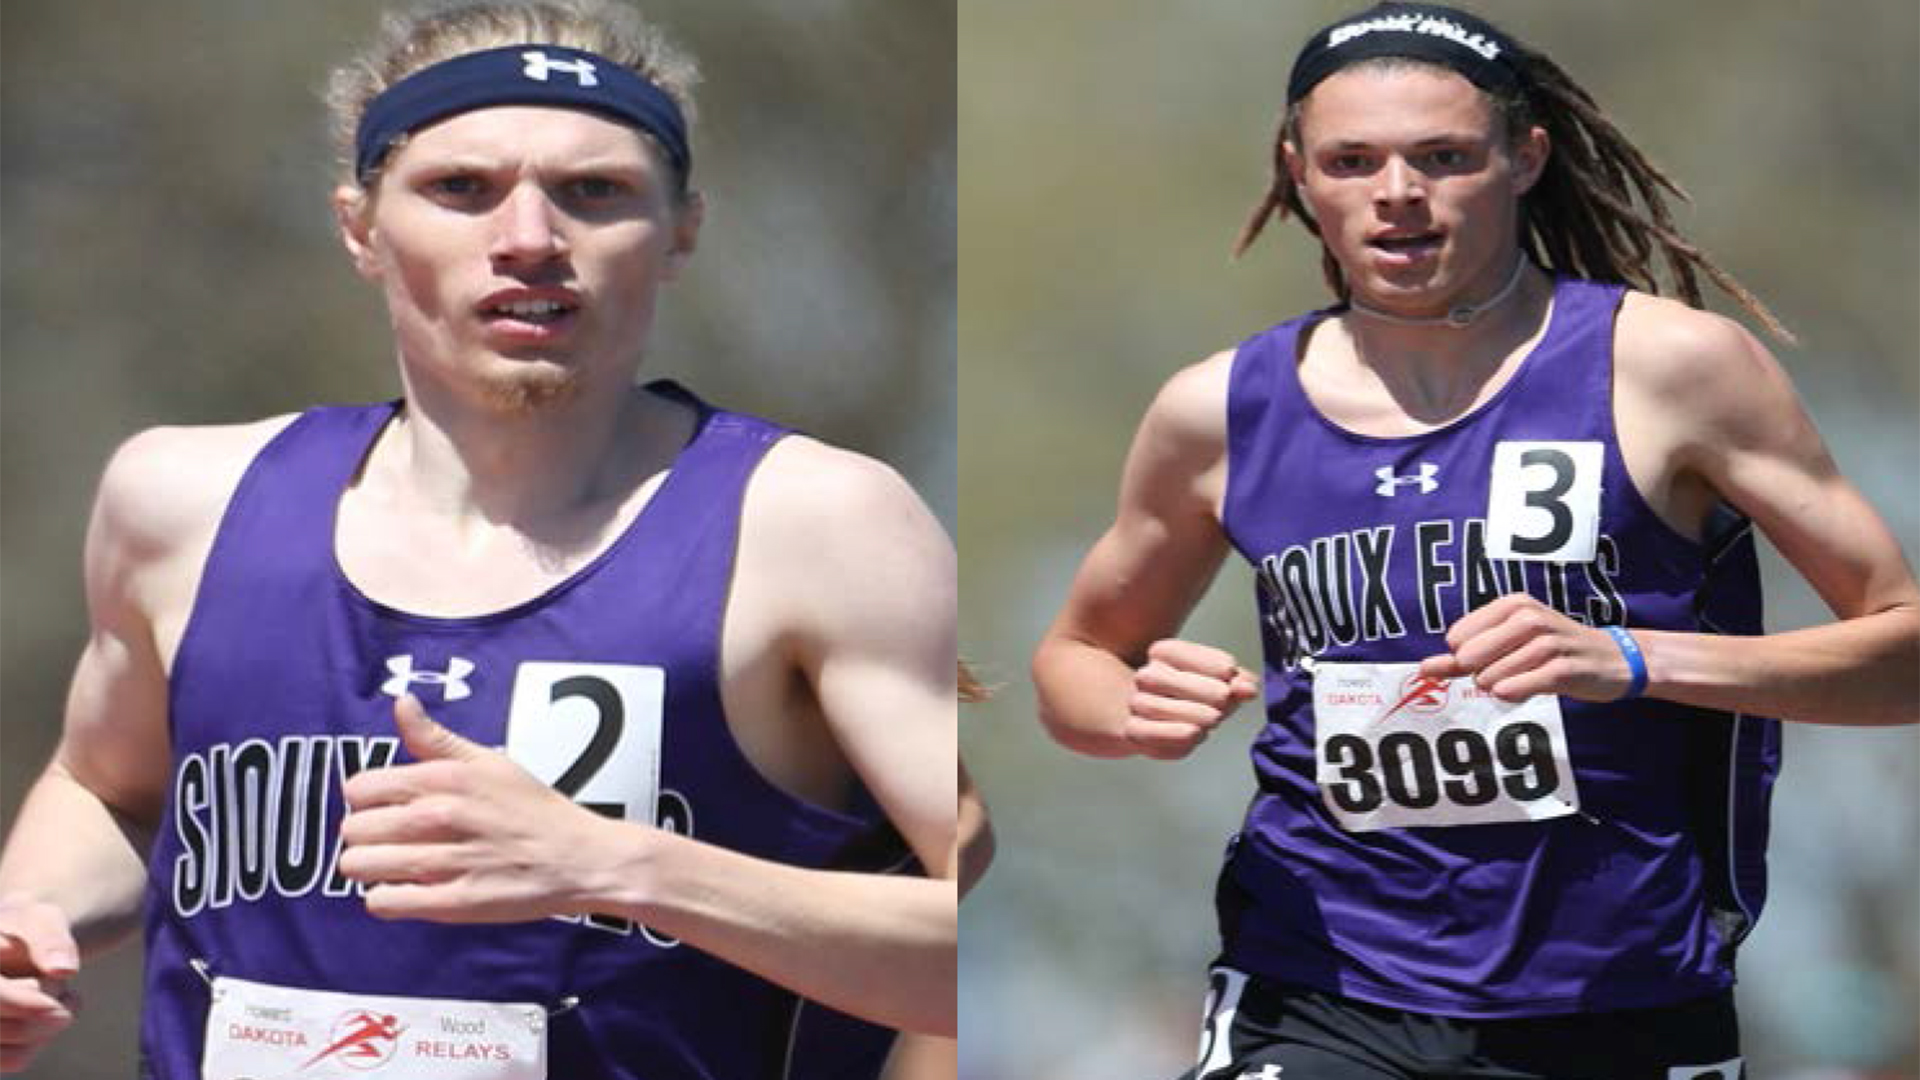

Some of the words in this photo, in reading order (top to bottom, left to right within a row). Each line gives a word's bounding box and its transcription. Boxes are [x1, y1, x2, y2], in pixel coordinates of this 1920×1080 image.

[1510, 449, 1577, 556] 3
[549, 674, 626, 820] 2
[1323, 720, 1560, 814] 3099
[228, 1023, 308, 1048] DAKOTA
[415, 1041, 511, 1061] RELAYS
[440, 1015, 486, 1035] Wood
